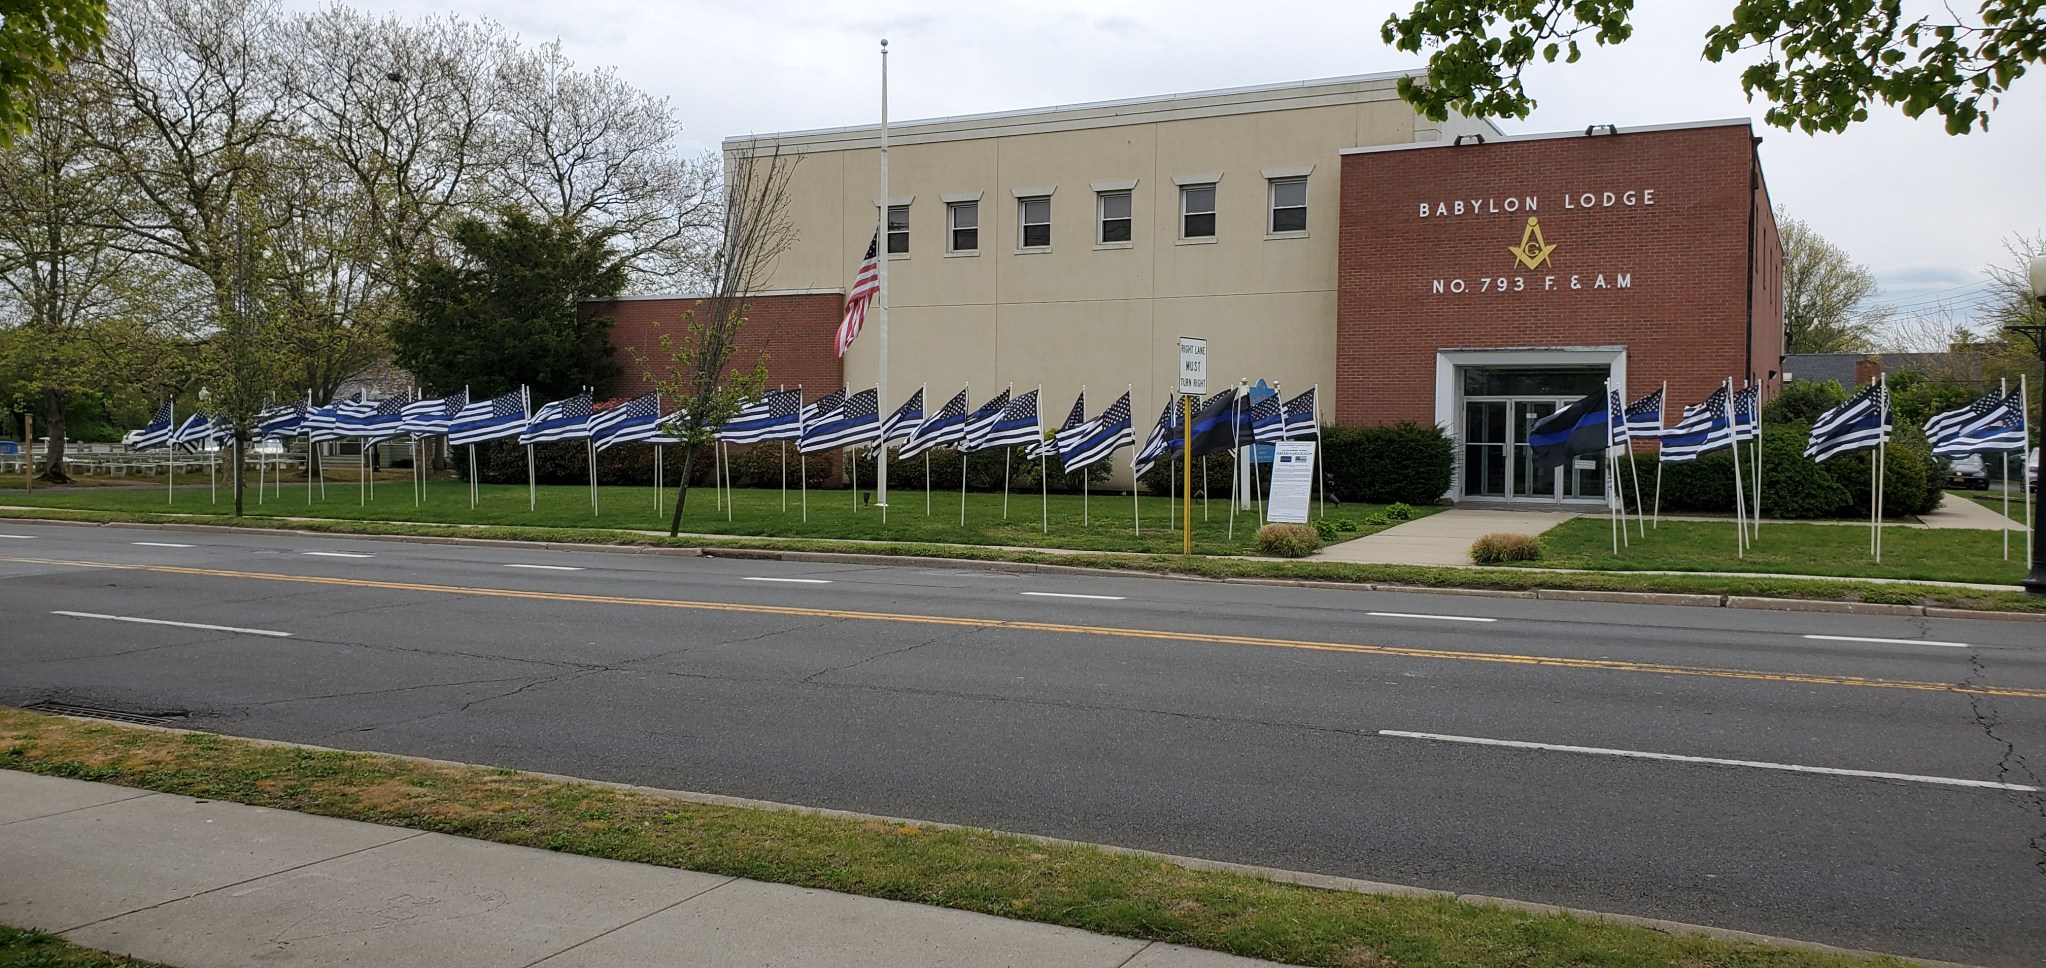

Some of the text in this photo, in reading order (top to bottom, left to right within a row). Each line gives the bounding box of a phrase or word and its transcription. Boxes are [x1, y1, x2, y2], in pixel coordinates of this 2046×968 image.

[1419, 189, 1655, 217] BABYLON LODGE
[1524, 242, 1540, 257] G
[1432, 278, 1469, 294] NO.
[1480, 277, 1525, 292] 793
[1545, 275, 1557, 290] F.
[1570, 274, 1582, 290] &
[1181, 344, 1205, 355] RIGHT LANE
[1186, 360, 1201, 372] MUST
[1181, 378, 1206, 388] TURN RIGHT
